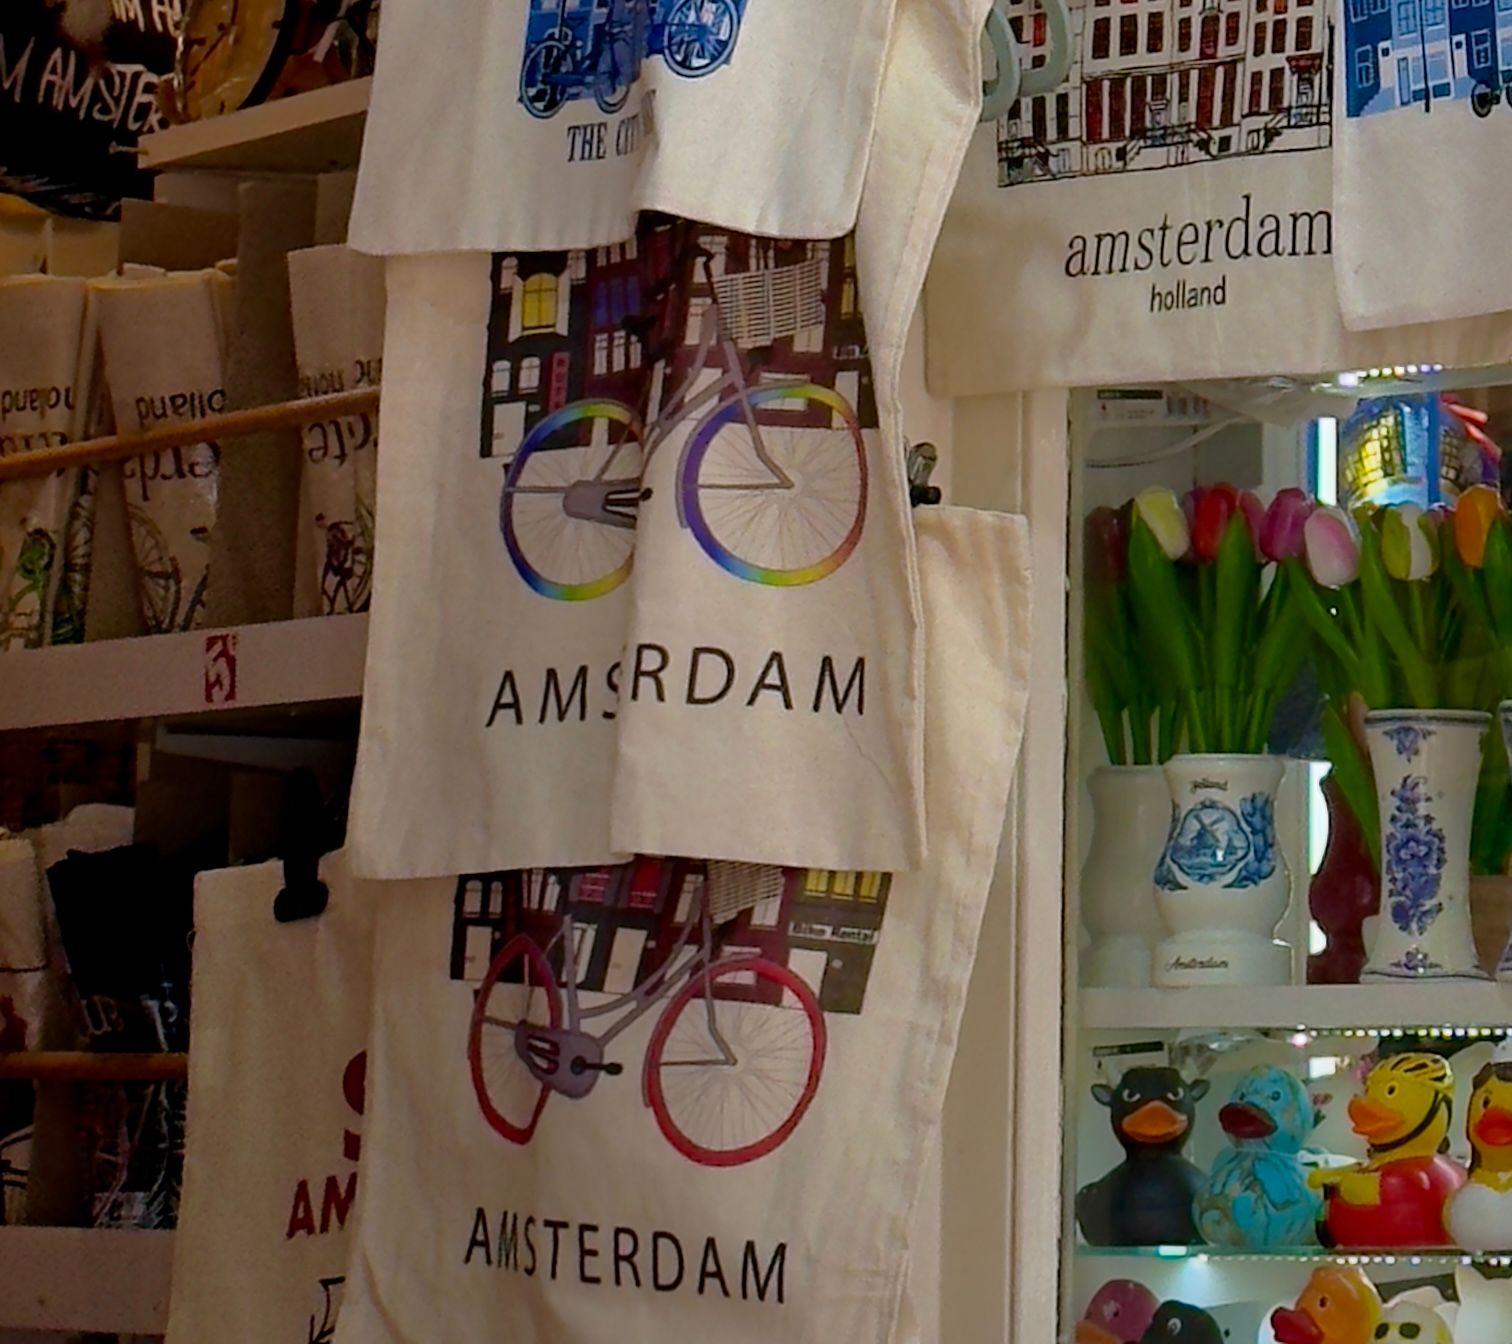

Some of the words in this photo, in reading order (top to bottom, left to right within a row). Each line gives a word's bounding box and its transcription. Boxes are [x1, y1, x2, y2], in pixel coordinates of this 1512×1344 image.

[568, 123, 606, 162] THE
[1063, 194, 1332, 277] amsterdam
[1148, 276, 1227, 313] holland
[486, 643, 866, 728] AMSRDAM
[464, 1206, 789, 1304] AMSTERDAM
